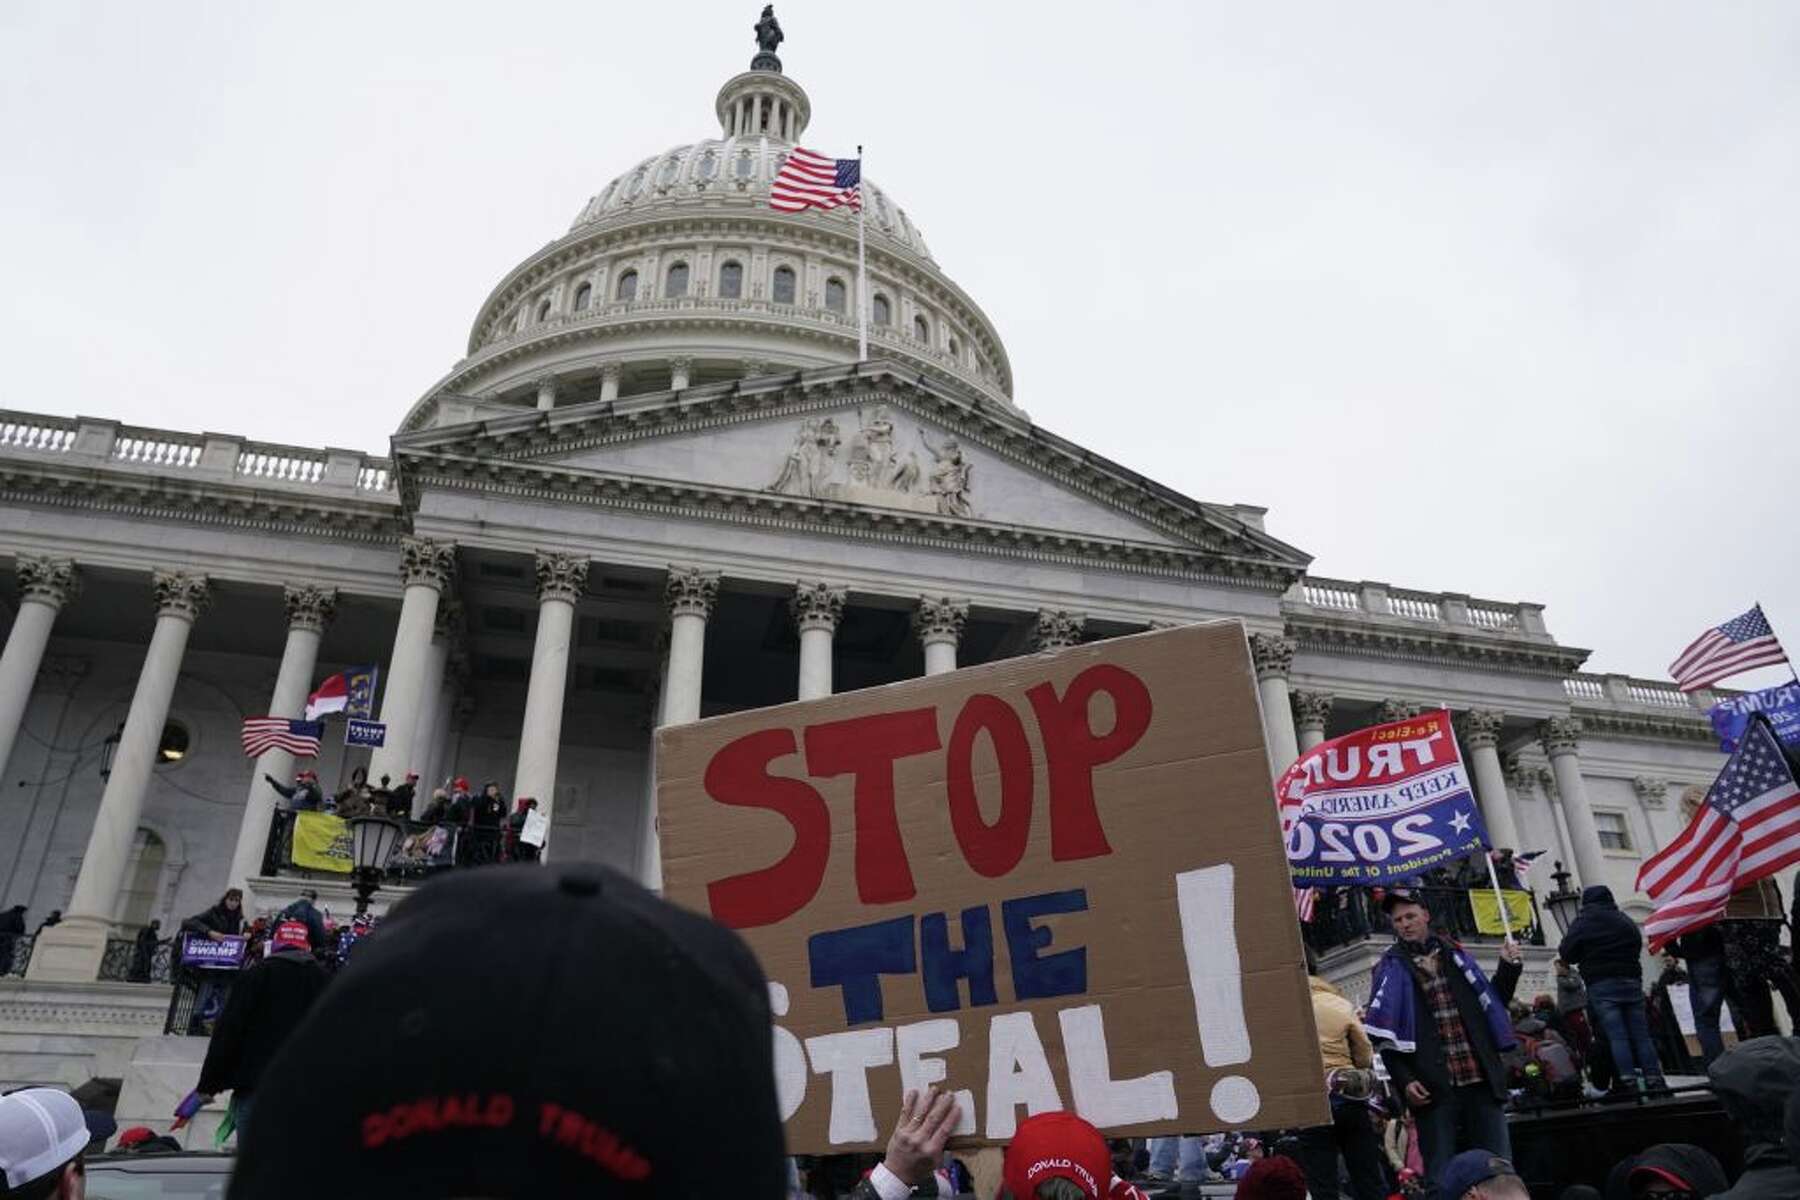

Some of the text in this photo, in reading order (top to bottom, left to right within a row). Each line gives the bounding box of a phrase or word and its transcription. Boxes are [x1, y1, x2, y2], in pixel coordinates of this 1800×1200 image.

[704, 664, 1152, 929] STOP
[188, 946, 237, 957] SWAMP
[808, 889, 1089, 1025] THE
[363, 1090, 514, 1150] DONALD
[1027, 1158, 1071, 1179] DONALD
